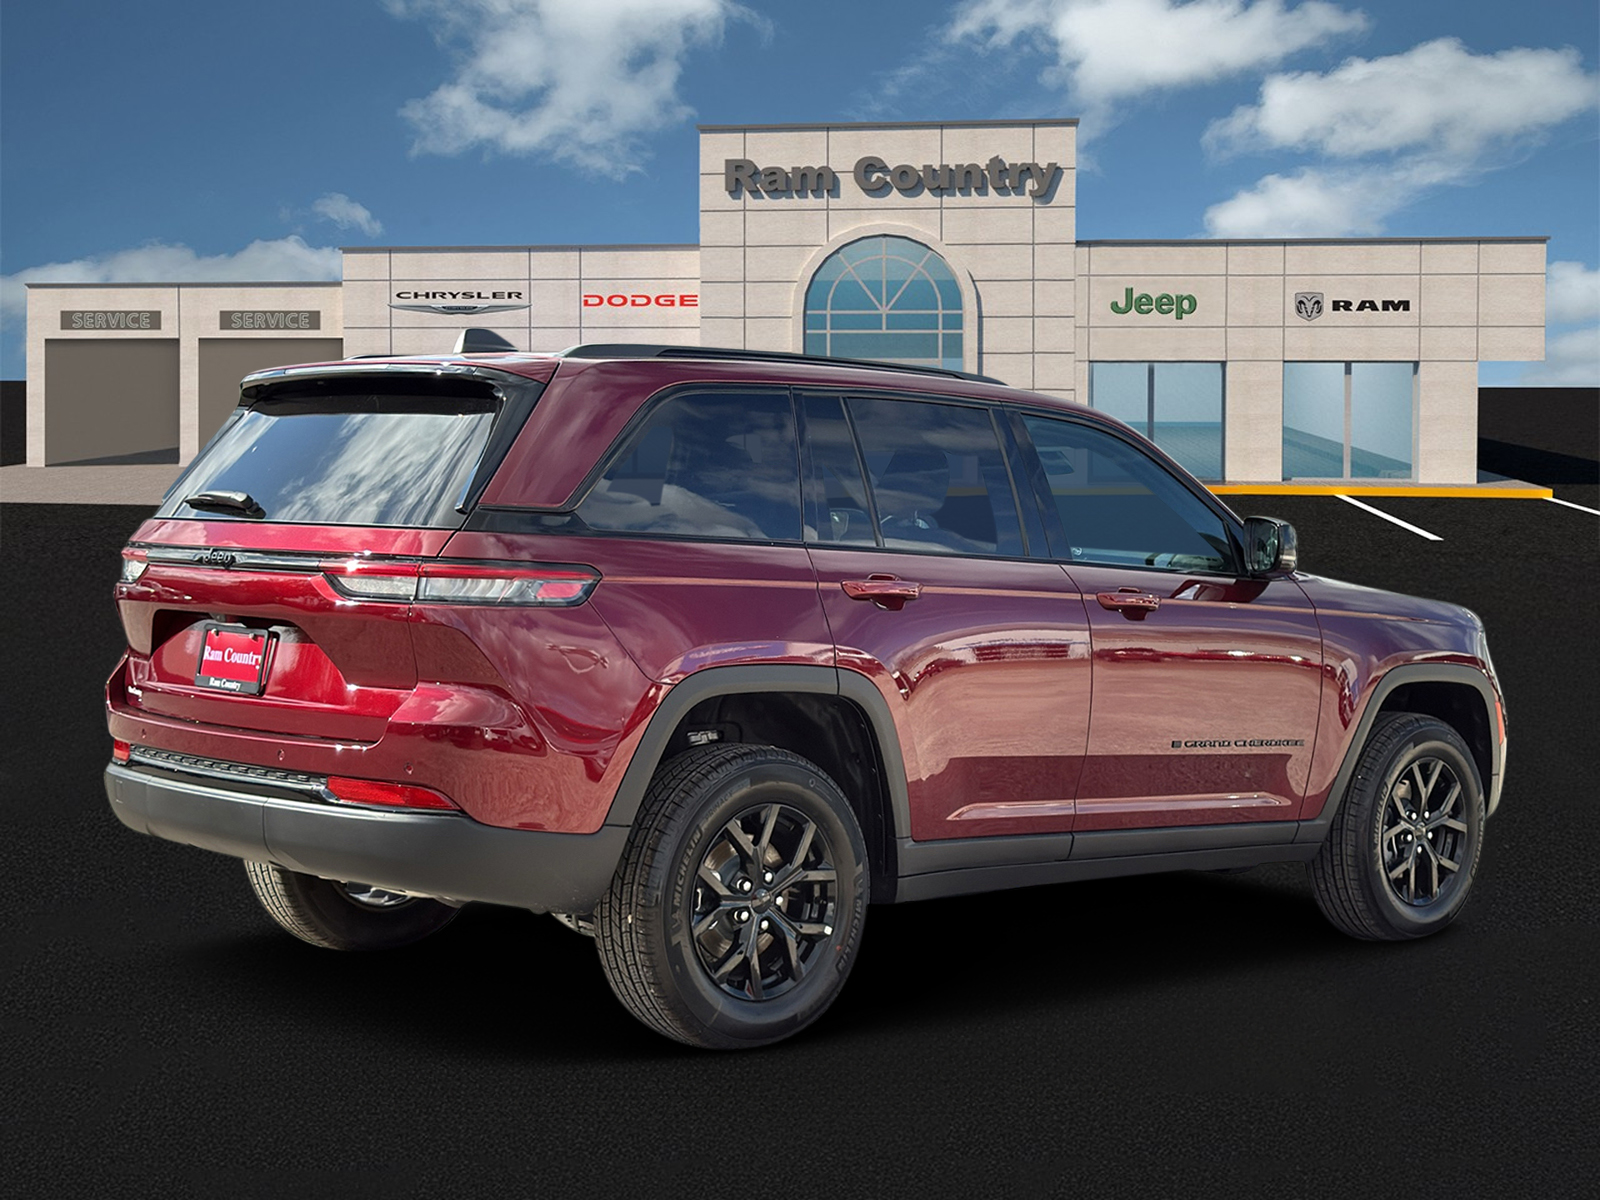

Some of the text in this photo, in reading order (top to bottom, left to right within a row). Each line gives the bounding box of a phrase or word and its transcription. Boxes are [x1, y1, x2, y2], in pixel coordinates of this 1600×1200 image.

[725, 155, 1058, 198] Ram Country
[395, 291, 523, 300] CHRYSLER
[583, 294, 699, 307] DODGE
[1110, 287, 1198, 320] Jeep
[1331, 299, 1411, 312] RAM
[71, 312, 151, 329] SERVICE
[230, 312, 310, 329] SERVICE
[203, 645, 223, 662] Ram
[1184, 740, 1232, 748] GRAND
[673, 828, 702, 907] MICHELIN
